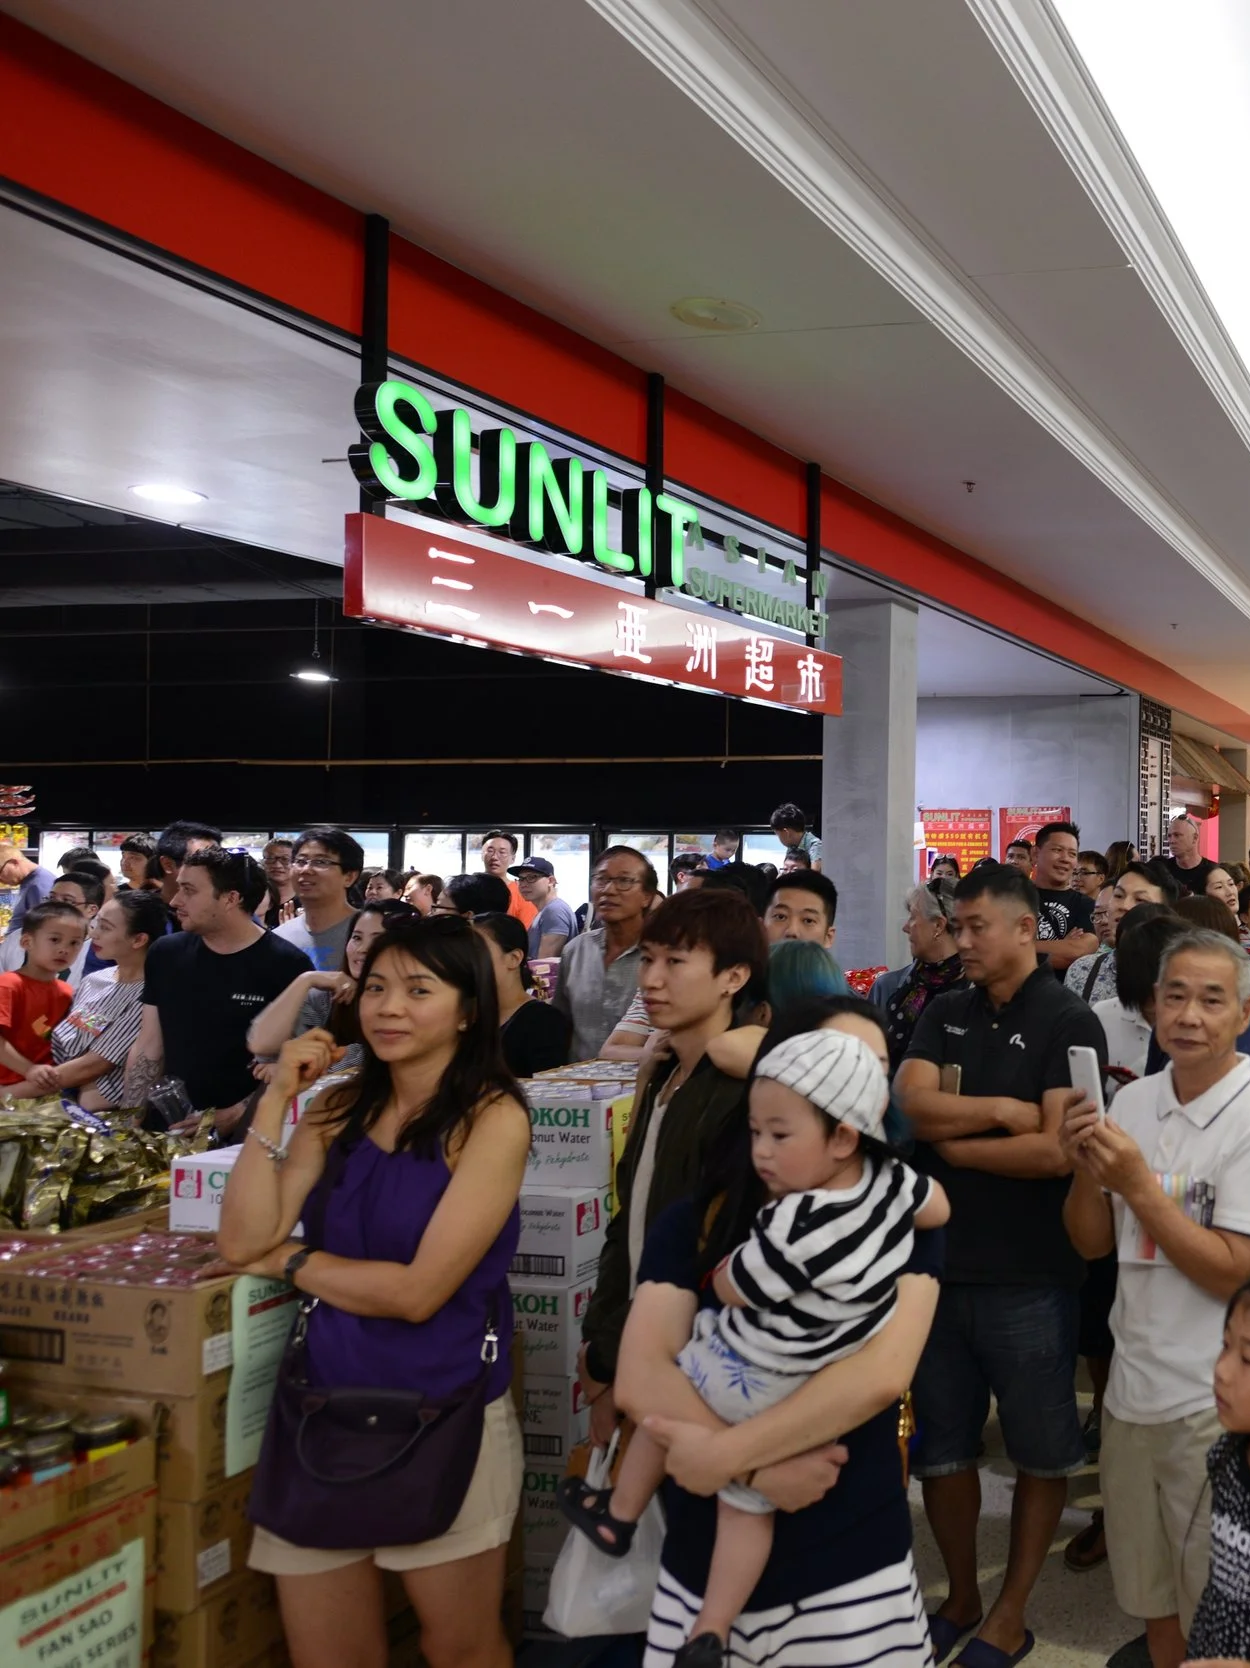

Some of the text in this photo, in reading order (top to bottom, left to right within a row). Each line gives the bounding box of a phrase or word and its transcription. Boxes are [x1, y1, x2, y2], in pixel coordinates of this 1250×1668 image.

[366, 379, 698, 588] SUNLIT
[688, 521, 827, 599] ASIAN
[687, 566, 829, 638] SUPERMARKET
[559, 1131, 591, 1144] Water
[526, 1319, 559, 1332] Water
[20, 1558, 128, 1625] SUNLIT
[37, 1631, 74, 1661] FAN
[77, 1608, 113, 1639] SAO
[86, 1620, 138, 1662] SERIES
